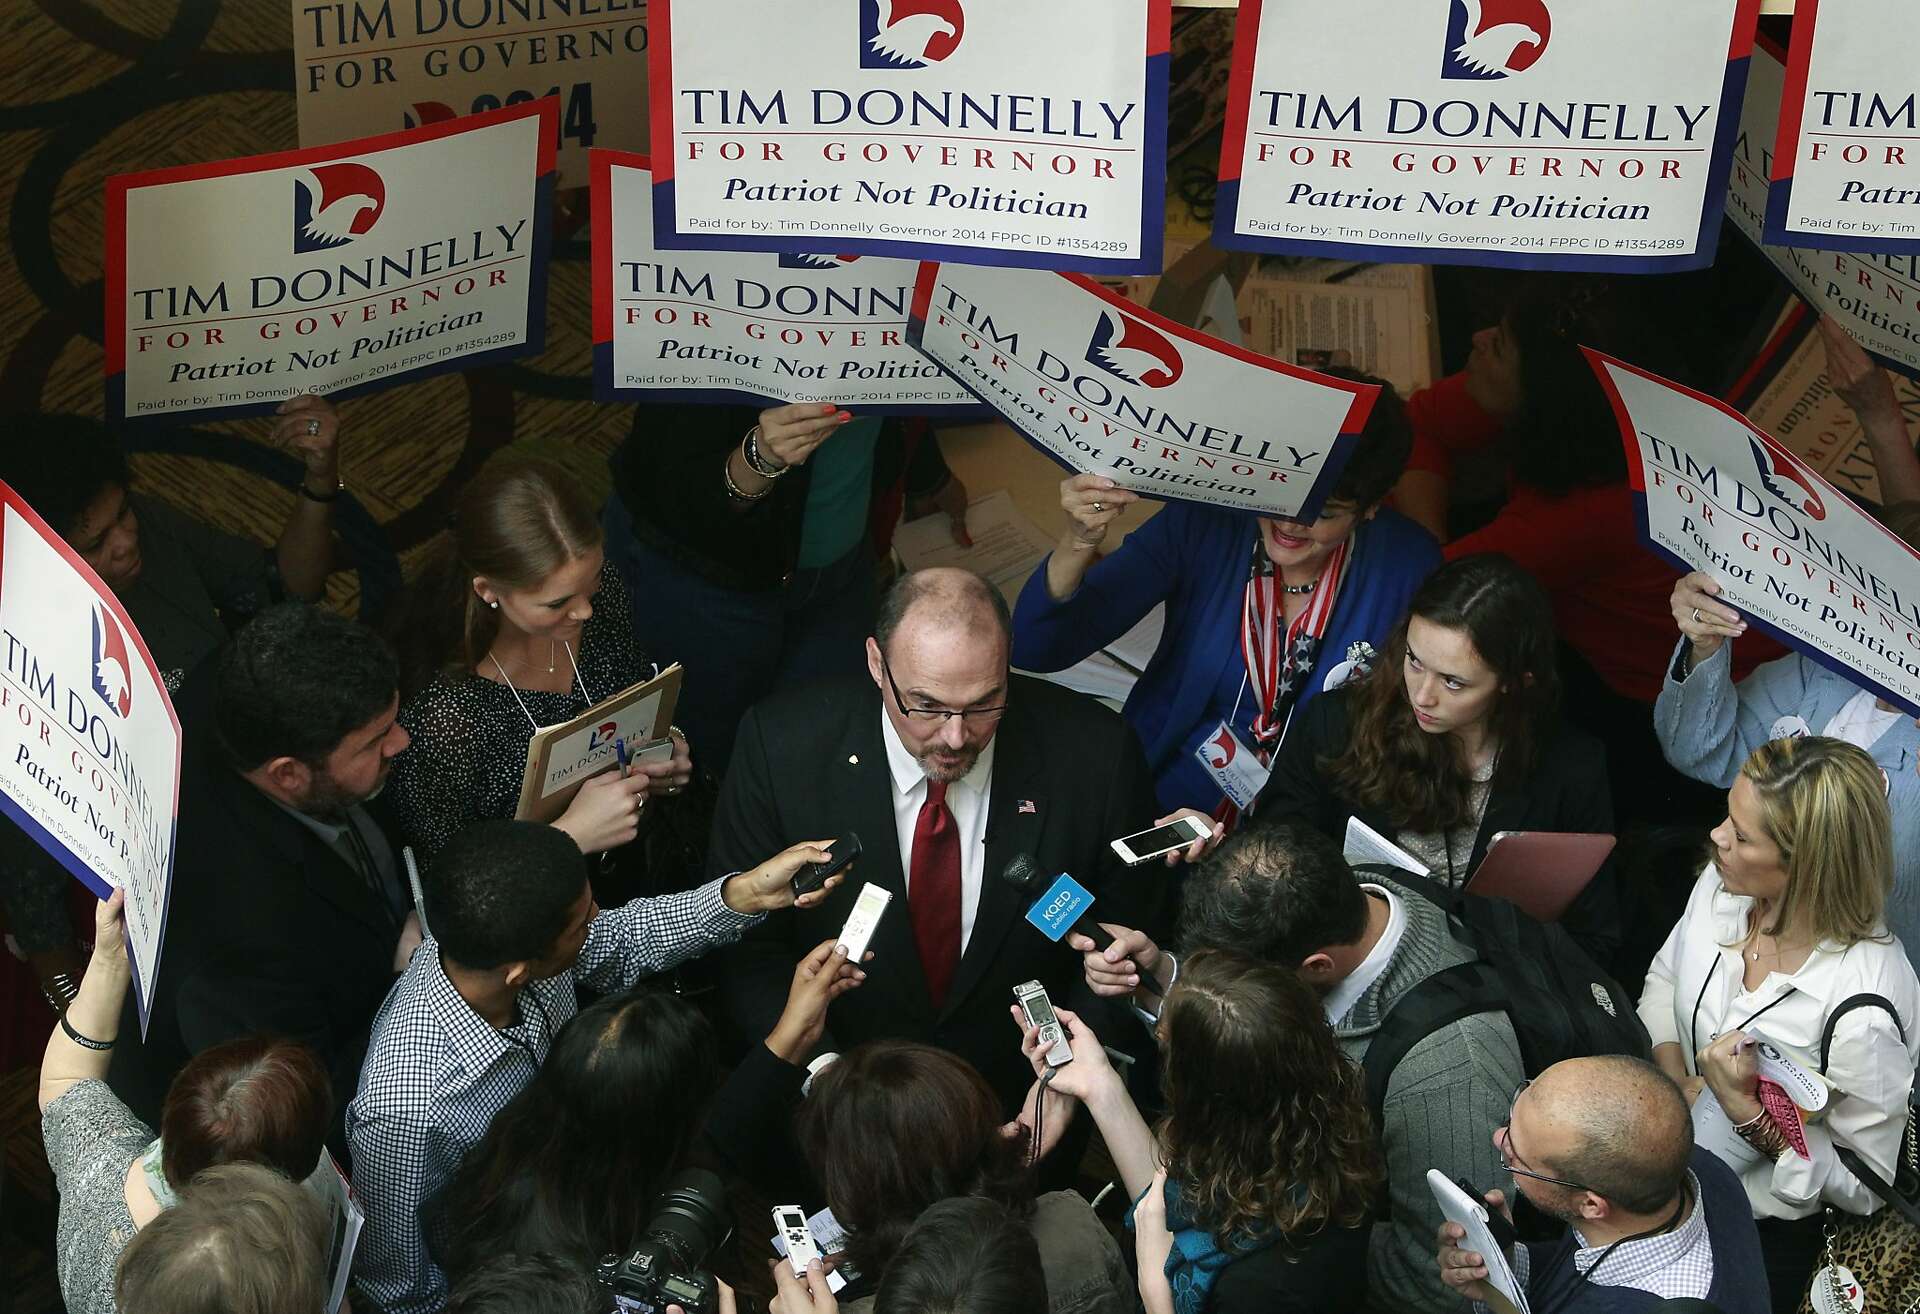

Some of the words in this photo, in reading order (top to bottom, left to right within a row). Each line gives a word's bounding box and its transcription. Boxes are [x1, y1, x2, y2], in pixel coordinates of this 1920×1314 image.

[304, 0, 396, 48] TIM
[308, 57, 398, 93] FOR
[424, 25, 648, 77] GOVERNO
[681, 89, 789, 126] TIM
[812, 88, 1136, 141] DONNELLY
[1259, 90, 1363, 133] TIM
[1387, 98, 1711, 143] DONNELLY
[1813, 90, 1917, 129] TIM
[688, 142, 785, 161] FOR
[823, 143, 1117, 180] GOVERNOR
[1257, 143, 1353, 169] FOR
[1392, 152, 1684, 180] GOVERNOR
[1810, 143, 1906, 165] FOR
[722, 178, 844, 204] Patriot
[856, 180, 917, 206] Not
[928, 184, 1089, 219] Politician
[1286, 182, 1407, 213] Patriot
[1416, 191, 1480, 218] Not
[1489, 193, 1651, 222] Politician
[1800, 216, 1832, 229] Paid
[1837, 219, 1857, 231] for
[1862, 221, 1884, 233] by:
[1889, 222, 1915, 233] Tim
[689, 217, 720, 230] Paid
[725, 217, 747, 231] for
[751, 218, 774, 233] by:
[779, 220, 805, 232] Tim
[810, 220, 875, 236] Donnelly
[879, 223, 948, 239] Governor
[952, 228, 987, 242] 2014
[991, 231, 1032, 246] FPPC
[1037, 234, 1052, 247] ID
[1056, 236, 1129, 254] #1354289
[1248, 219, 1279, 233] Paid
[1284, 221, 1305, 234] for
[1309, 223, 1333, 239] by:
[1338, 226, 1364, 239] Tim
[1368, 229, 1434, 245] Donnelly
[1438, 232, 1505, 247] Governor
[1510, 235, 1545, 248] 2014
[1549, 236, 1590, 250] FPPC
[1594, 237, 1610, 250] ID
[1614, 237, 1686, 251] #1354289
[133, 281, 230, 320] TIM
[250, 219, 526, 309] DONNELLY
[620, 262, 716, 302] TIM
[735, 278, 916, 317] DONN
[138, 328, 225, 352] FOR
[260, 269, 508, 340] GOVERNOR
[626, 308, 712, 328] FOR
[745, 323, 901, 347] GOVER
[137, 400, 166, 412] Paid
[170, 397, 188, 407] for
[217, 392, 241, 402] Tim
[245, 384, 303, 399] Donnelly
[308, 371, 365, 394] Governor
[369, 360, 398, 377] 2014
[401, 350, 435, 368] FPPC
[438, 346, 452, 358] ID
[456, 331, 516, 353] #1354289
[168, 356, 277, 384] Patriot
[286, 348, 340, 373] Not
[350, 309, 484, 361] Politician
[656, 340, 763, 370] Patriot
[773, 358, 835, 380] Not
[1869, 336, 1900, 355] FPPC
[626, 375, 655, 384] Paid
[659, 375, 677, 384] for
[682, 375, 702, 385] by:
[706, 376, 730, 384] Tim
[735, 377, 791, 399] Donnelly
[794, 392, 856, 402] Governor
[860, 392, 891, 400] 2014
[897, 392, 933, 400] FPPC
[937, 391, 951, 399] ID
[937, 313, 1008, 374] FOR
[1038, 386, 1289, 484] GOVERNOR
[941, 284, 1018, 356] TIM
[1037, 349, 1320, 469] DONNELLY
[959, 352, 1048, 425] Patriot
[1054, 421, 1104, 461] Not
[1111, 453, 1258, 498] Politician
[1777, 373, 1831, 436] olitician
[1016, 416, 1065, 454] Donnelly
[1641, 431, 1720, 498] TIM
[1654, 471, 1715, 528] FOR
[1742, 531, 1920, 650] GOVERNO
[1657, 531, 1680, 552] Paid
[1681, 515, 1756, 585] Patriot
[1763, 573, 1811, 614] Not
[1819, 602, 1920, 679] Politicia
[1728, 590, 1779, 622] Donnelly
[1781, 617, 1834, 651] Governor
[1836, 647, 1863, 668] 2014
[1866, 663, 1897, 687] FPPC
[1899, 682, 1912, 696] ID
[1, 686, 51, 748] FOR
[3, 629, 57, 712] TIM
[67, 687, 167, 884] DONNELLY
[551, 764, 573, 782] TIM
[0, 774, 12, 790] aid
[56, 822, 93, 862] Donnelly
[14, 743, 80, 815] Patriot
[84, 802, 117, 849] Not
[1042, 891, 1071, 921] KQED
